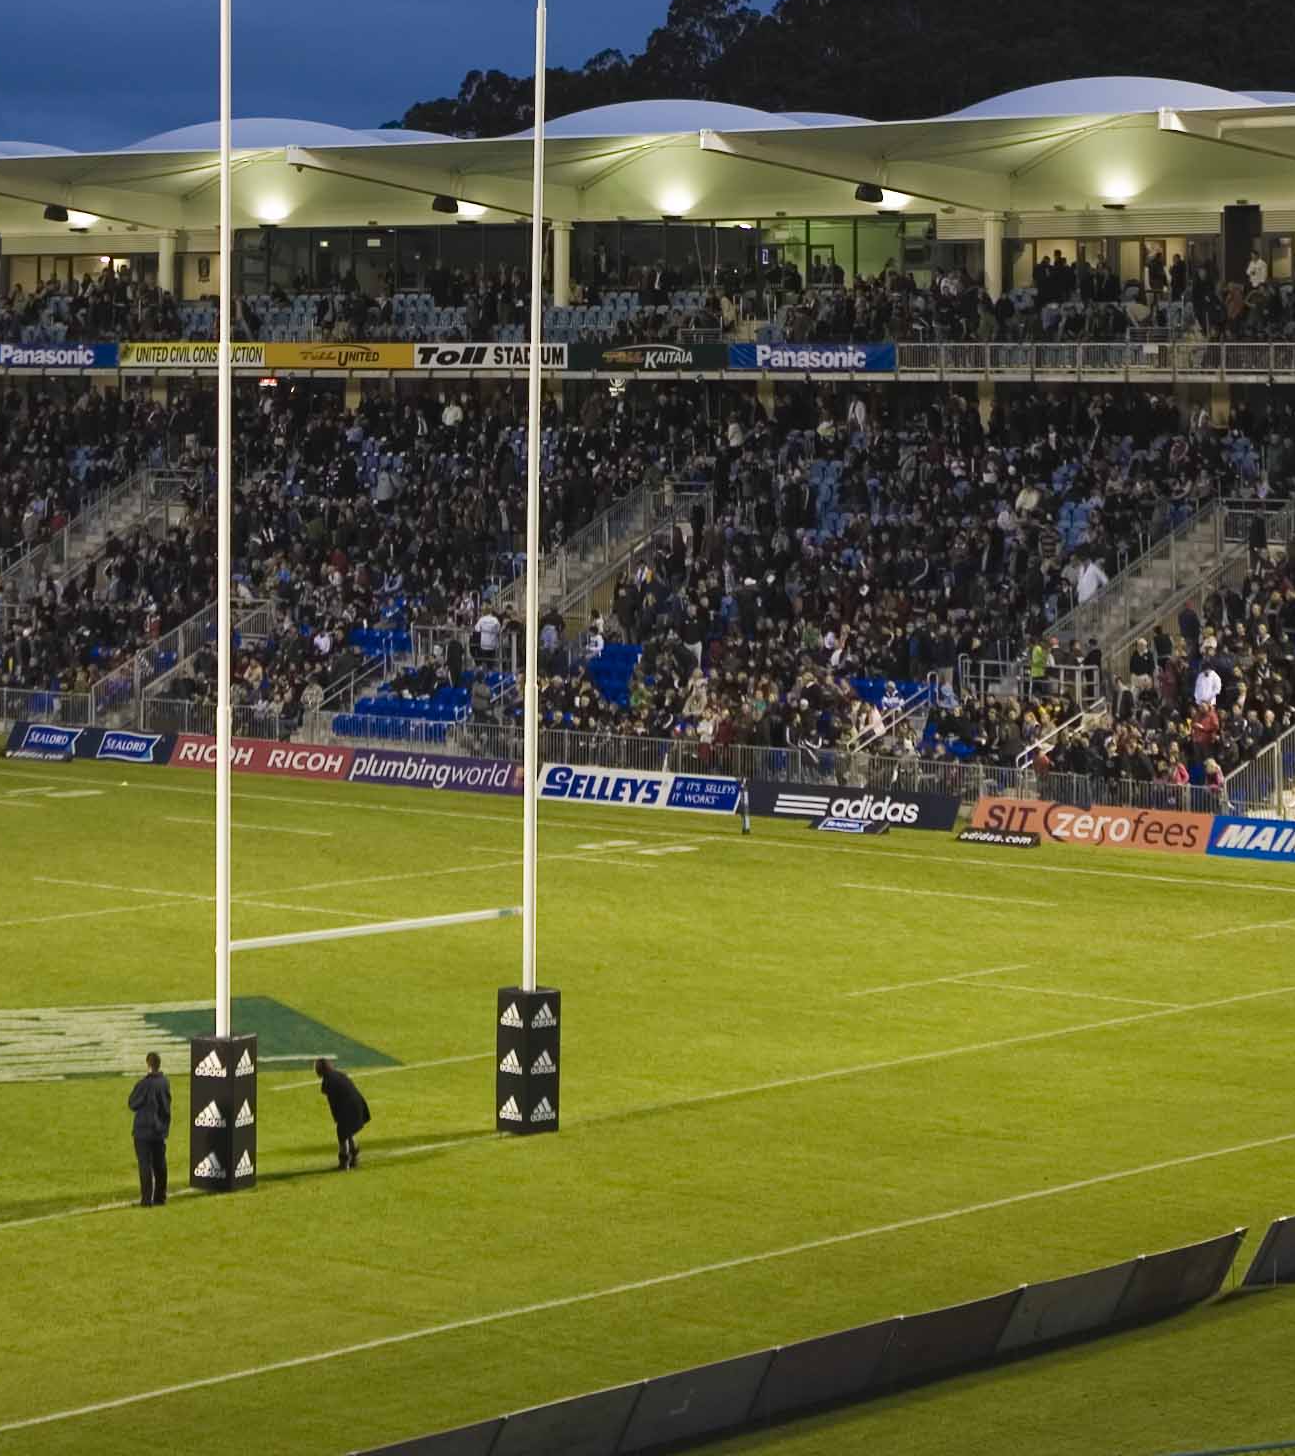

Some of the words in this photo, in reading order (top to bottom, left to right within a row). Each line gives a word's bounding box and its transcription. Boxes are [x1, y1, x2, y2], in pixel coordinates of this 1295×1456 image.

[0, 345, 94, 365] Panasonic
[136, 346, 168, 363] UNITED
[170, 347, 195, 364] CIVIL
[196, 347, 262, 364] CONSUCTION
[337, 351, 380, 367] UNITED
[417, 346, 487, 366] Toll
[494, 346, 564, 366] STADUM
[644, 351, 692, 368] KAITAIA
[756, 345, 866, 368] Panasonic
[28, 731, 69, 746] SEALORD
[106, 734, 147, 753] SEALORD
[266, 749, 344, 774] RICOH
[349, 751, 513, 789] plumbingworld
[540, 766, 663, 804] SELLEYS
[687, 782, 701, 793] IT'S
[705, 784, 736, 795] SELLEYS
[830, 793, 920, 824] adidas
[984, 803, 1038, 833] SIT
[959, 831, 1033, 846] adidas.com
[195, 1065, 227, 1077] adidas
[194, 1117, 227, 1128] adidas
